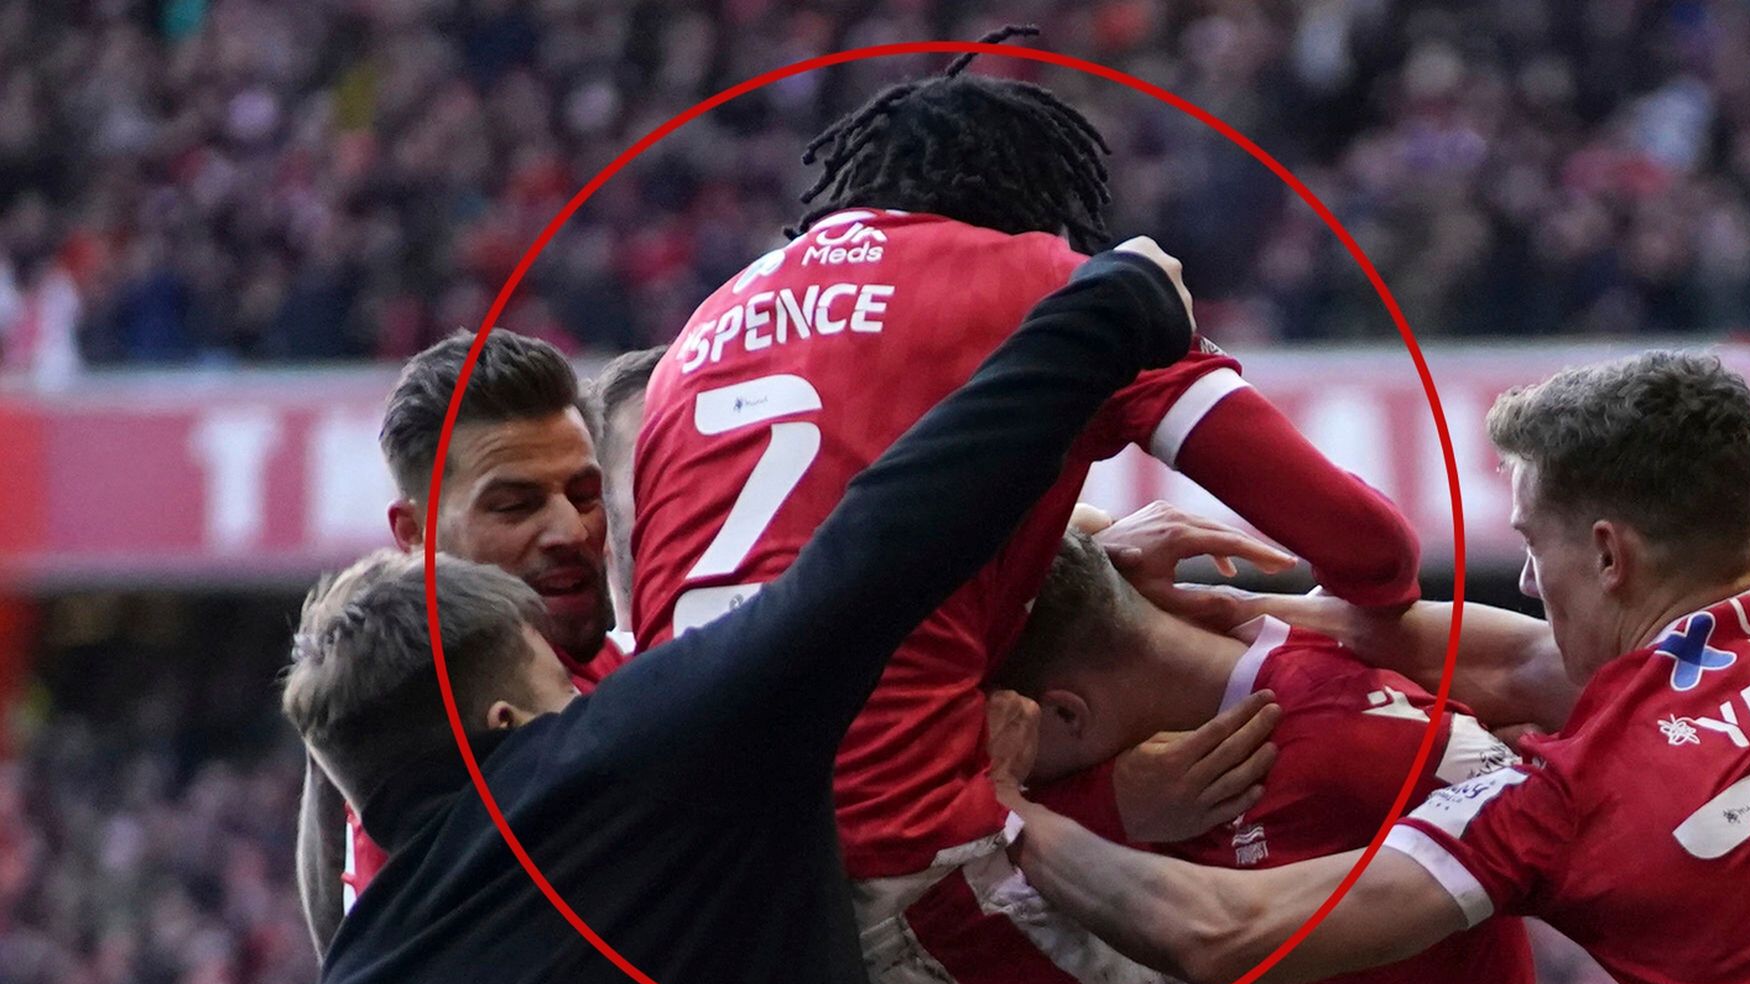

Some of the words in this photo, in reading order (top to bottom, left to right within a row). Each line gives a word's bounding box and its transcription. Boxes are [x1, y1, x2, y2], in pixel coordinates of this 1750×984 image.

[801, 241, 884, 266] Meds
[676, 283, 895, 374] SPENCE
[673, 374, 823, 640] 2
